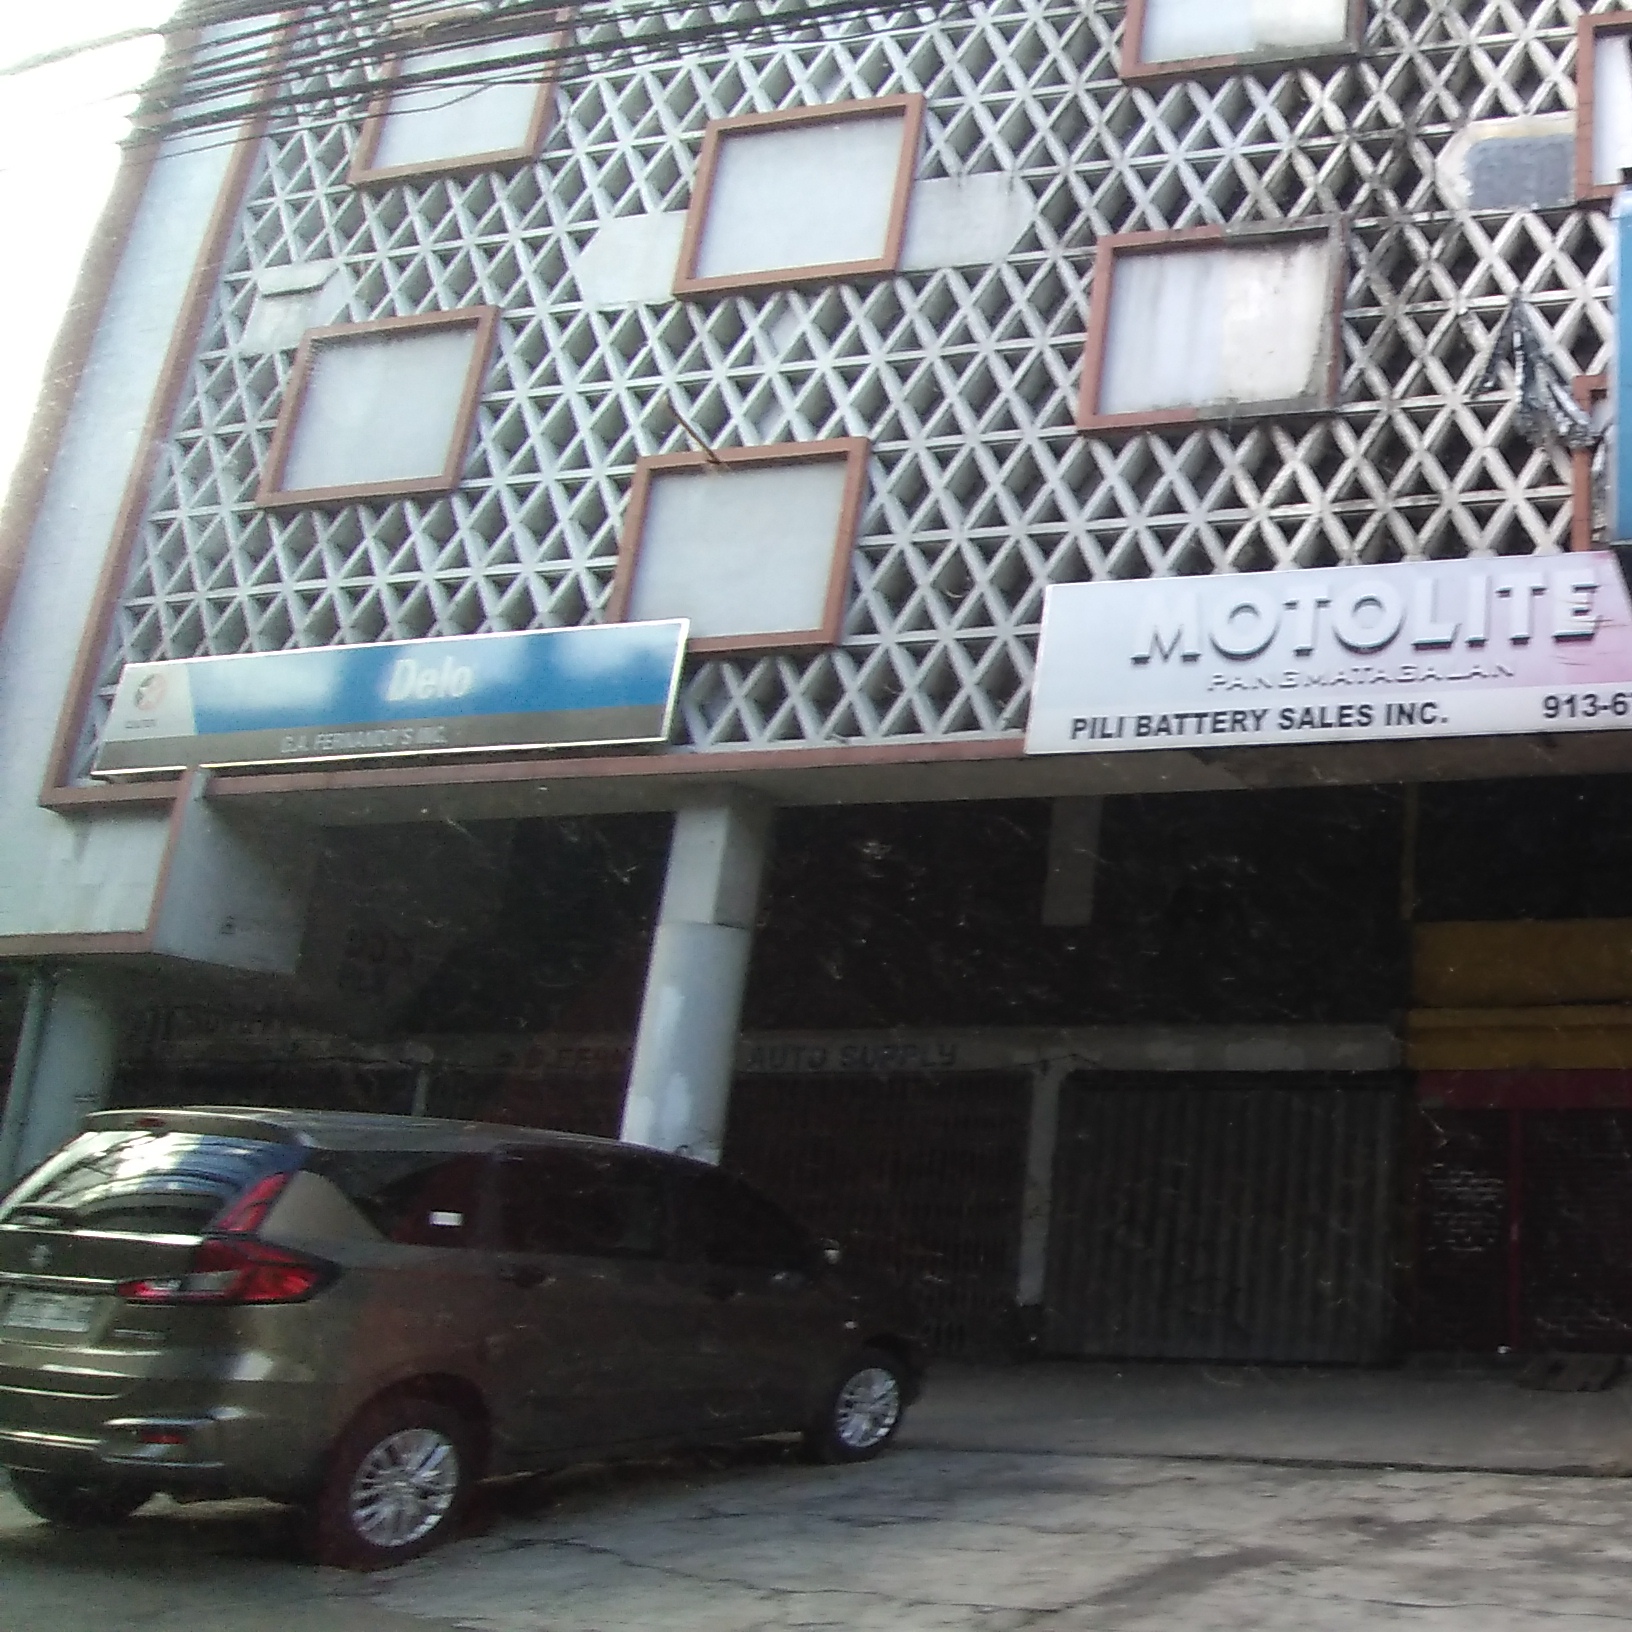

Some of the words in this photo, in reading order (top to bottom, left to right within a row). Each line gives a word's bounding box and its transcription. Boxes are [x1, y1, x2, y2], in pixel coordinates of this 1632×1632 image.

[1131, 571, 1599, 664] MOTOLITE
[387, 656, 473, 701] Delo
[1069, 716, 1126, 740] PILI
[1135, 708, 1271, 738] BATTERY
[1278, 704, 1374, 731] SALES
[1385, 702, 1450, 726] INC.
[746, 1044, 828, 1070] AUTO
[840, 1041, 958, 1069] SUPPLY
